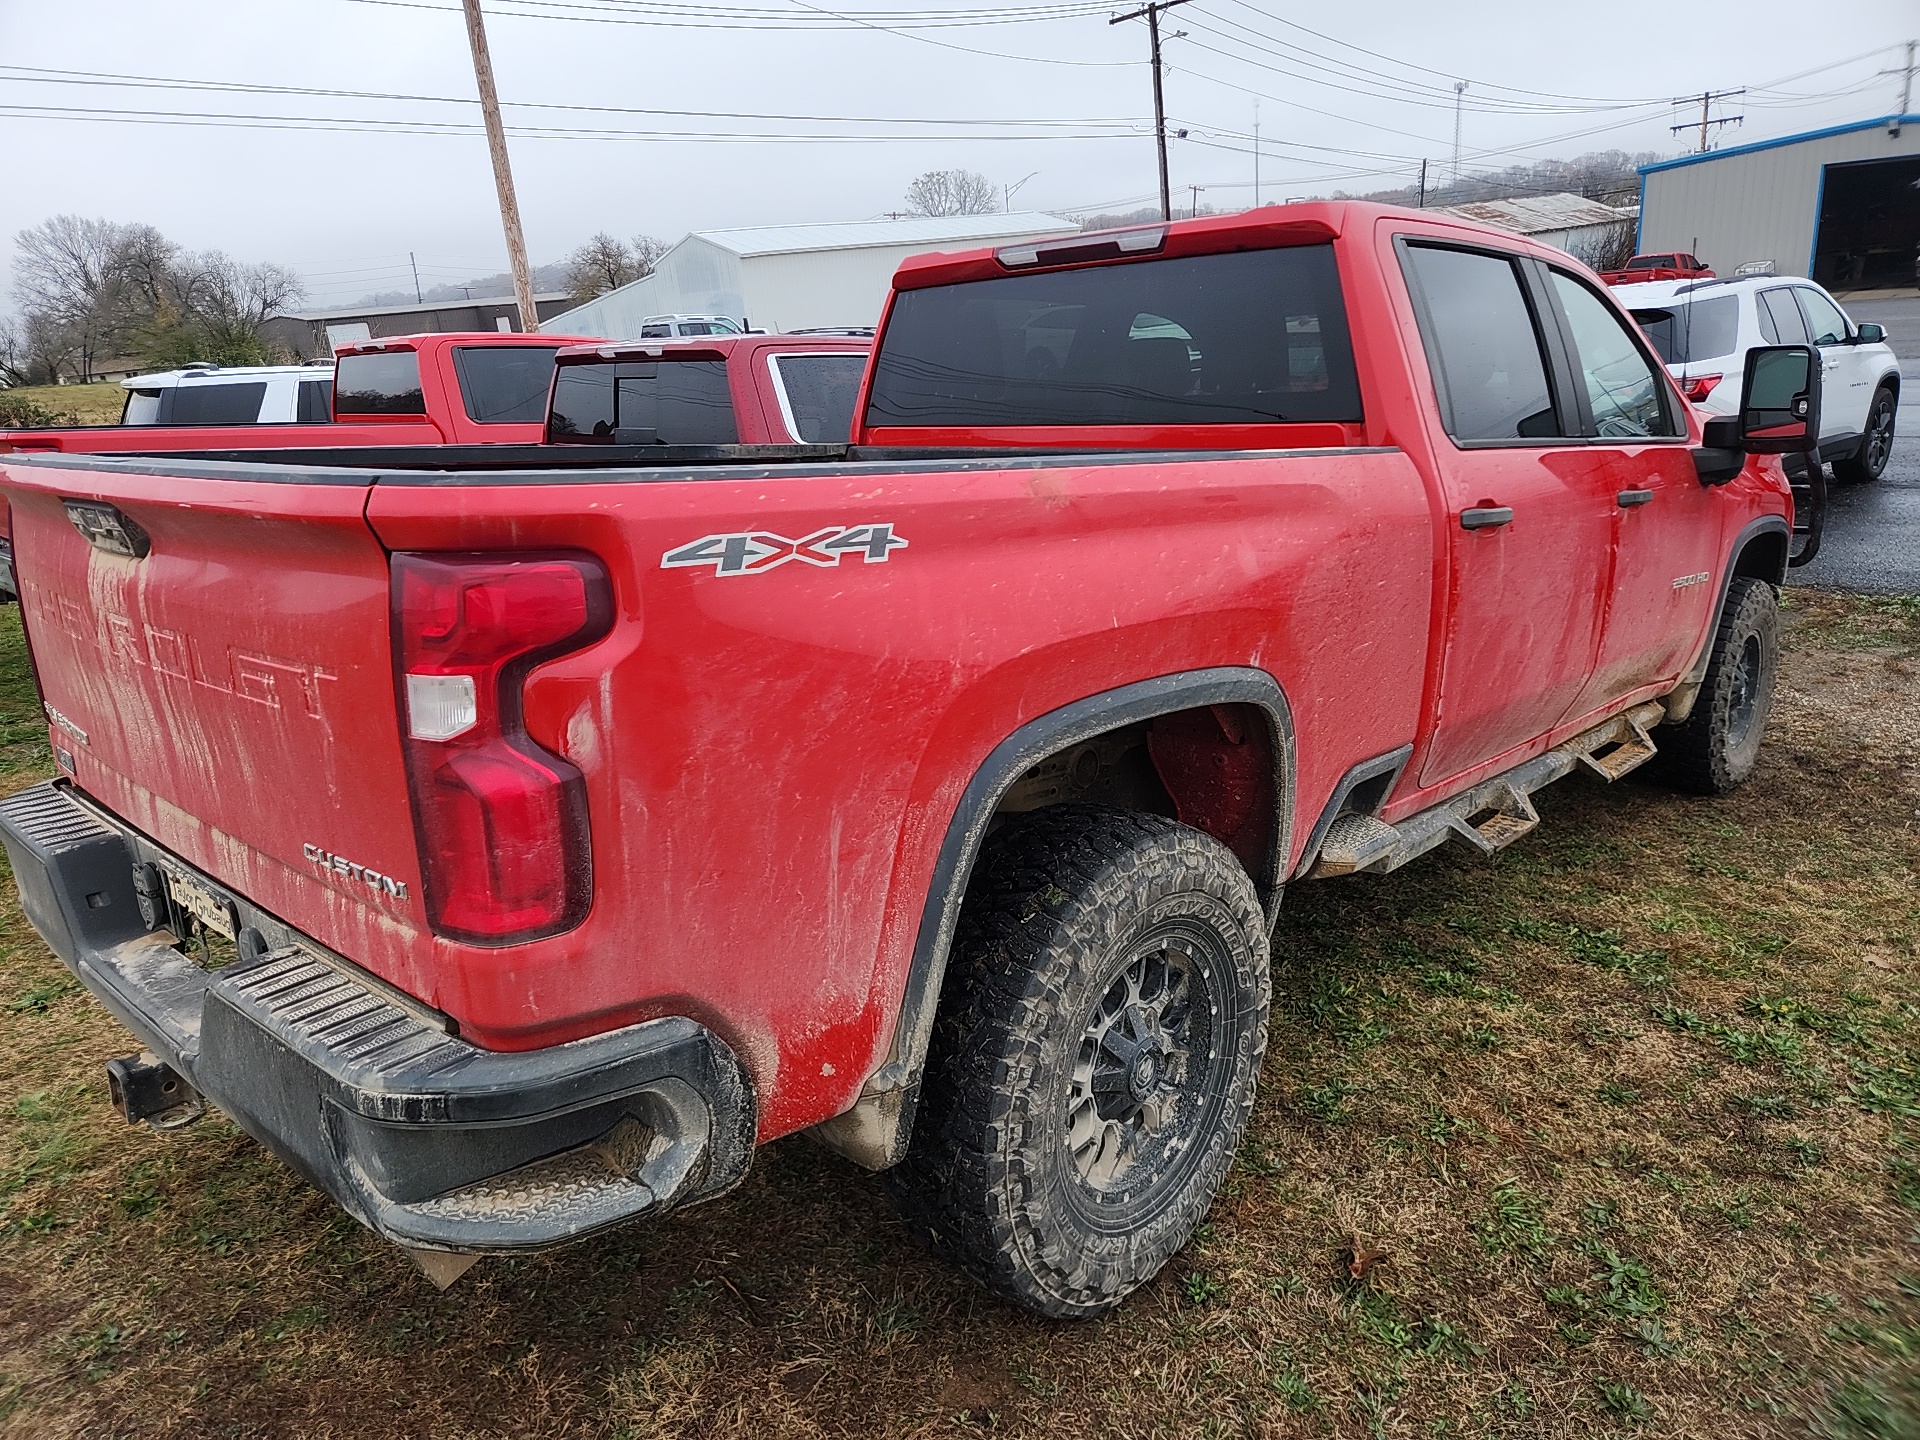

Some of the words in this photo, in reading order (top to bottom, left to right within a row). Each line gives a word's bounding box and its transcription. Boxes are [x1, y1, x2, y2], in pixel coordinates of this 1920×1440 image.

[660, 523, 909, 577] 4X4
[303, 842, 409, 900] CUSTOM
[1152, 900, 1215, 924] TOYO
[1209, 910, 1252, 989] TIRES
[1221, 1031, 1250, 1132] OPEN
[1131, 1131, 1224, 1250] COUNTRY
